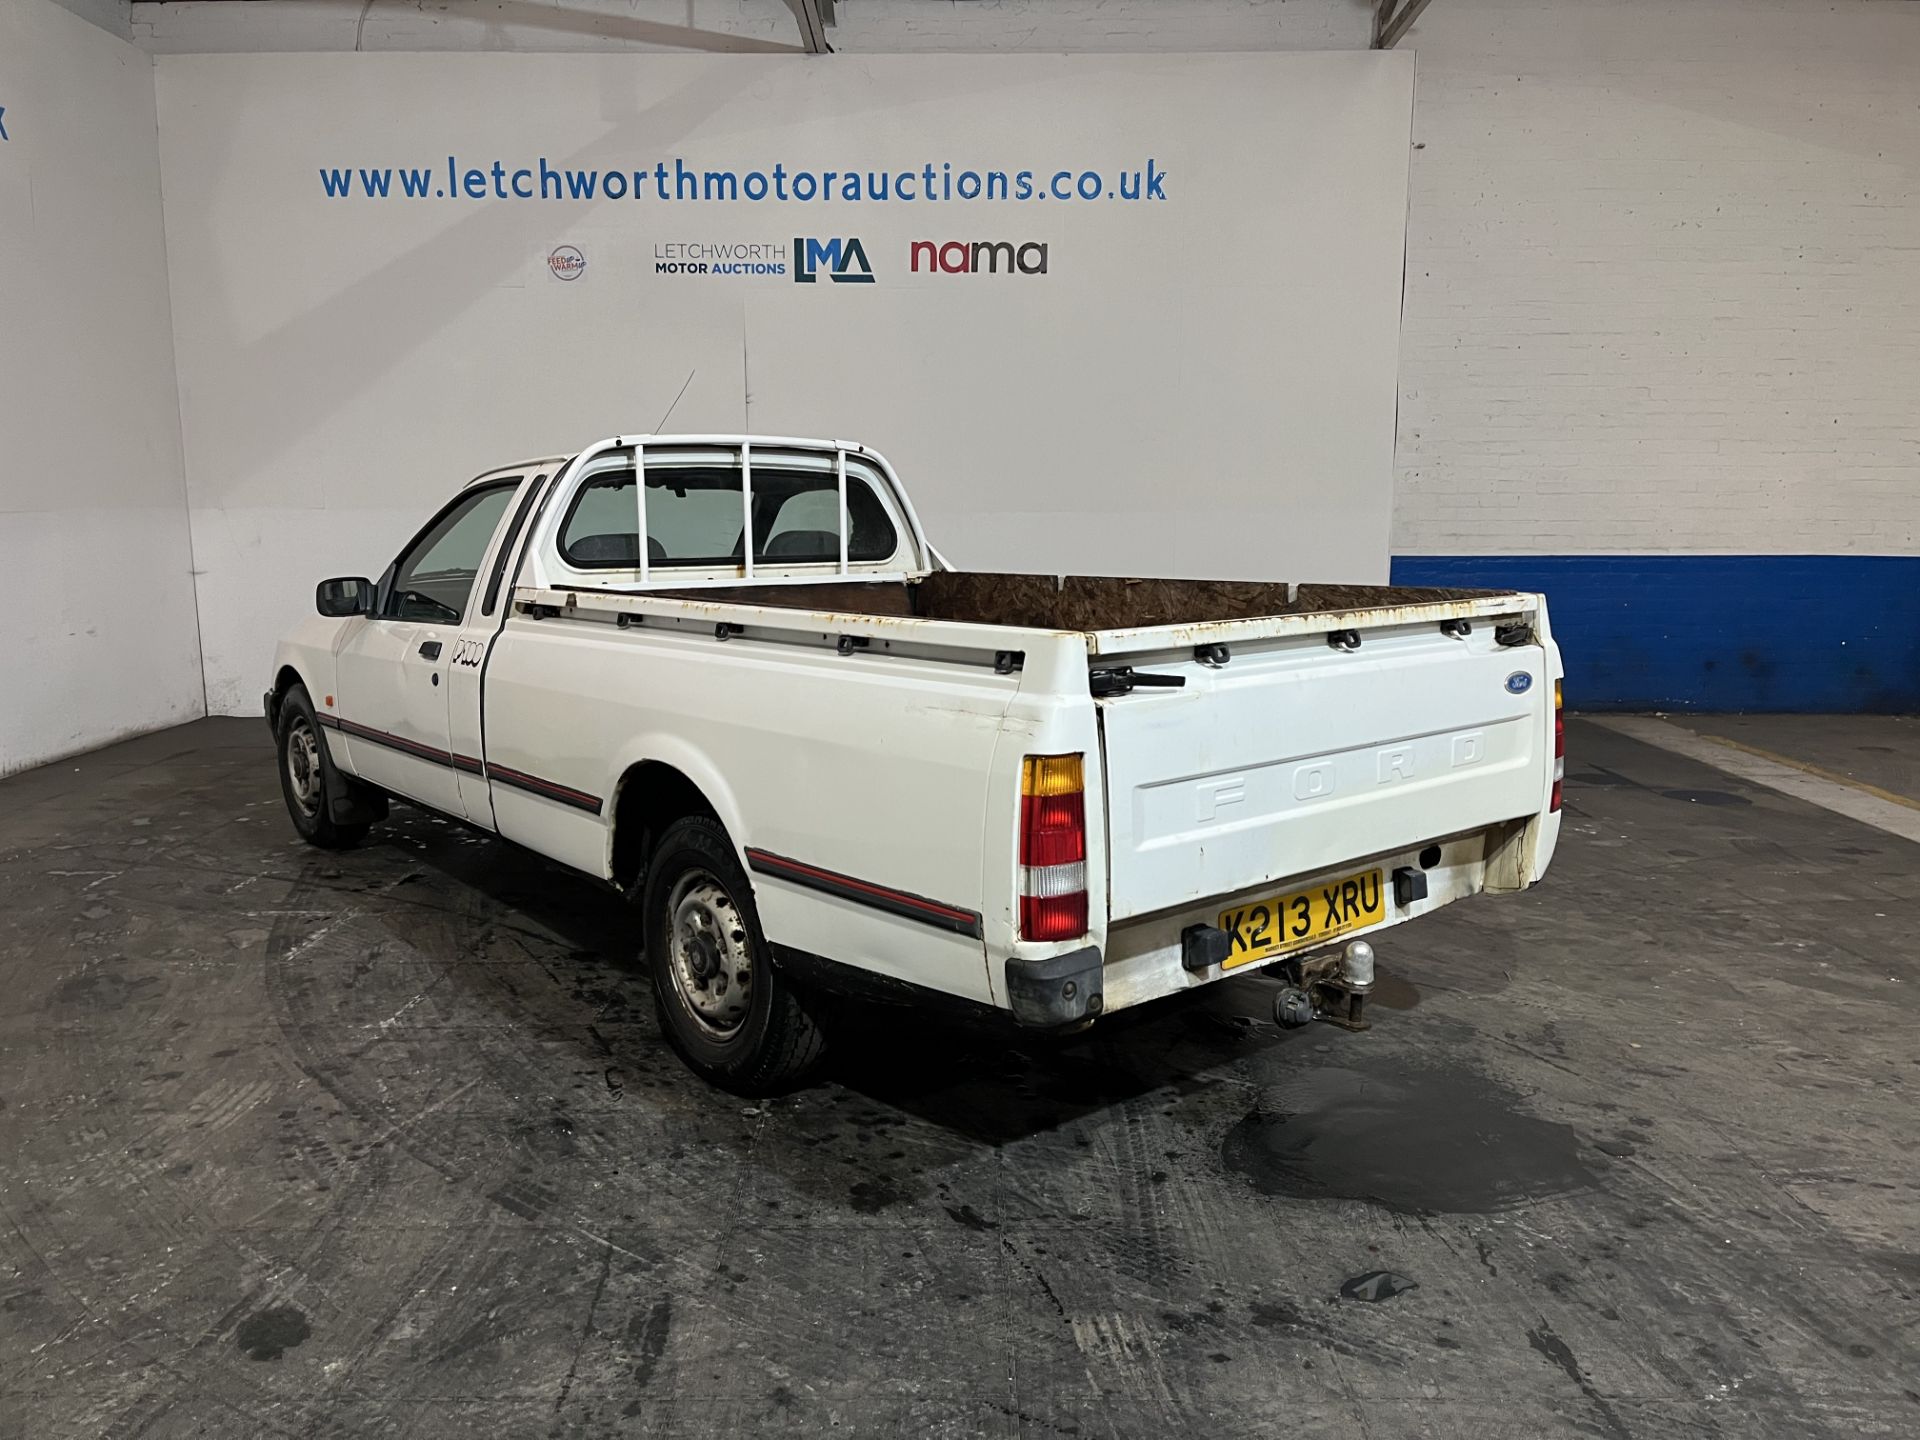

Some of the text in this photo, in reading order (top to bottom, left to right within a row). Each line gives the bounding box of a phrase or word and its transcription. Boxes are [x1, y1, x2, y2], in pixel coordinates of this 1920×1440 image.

[320, 156, 1167, 202] www.letchworthmotorauctions.co.uk
[655, 244, 785, 259] LETCHWORTH
[655, 262, 786, 275] MOTOR AUCTIONS
[793, 237, 876, 284] LMA
[910, 240, 1049, 275] nama
[1196, 732, 1484, 823] FORD
[1225, 872, 1379, 952] K213 XRU
